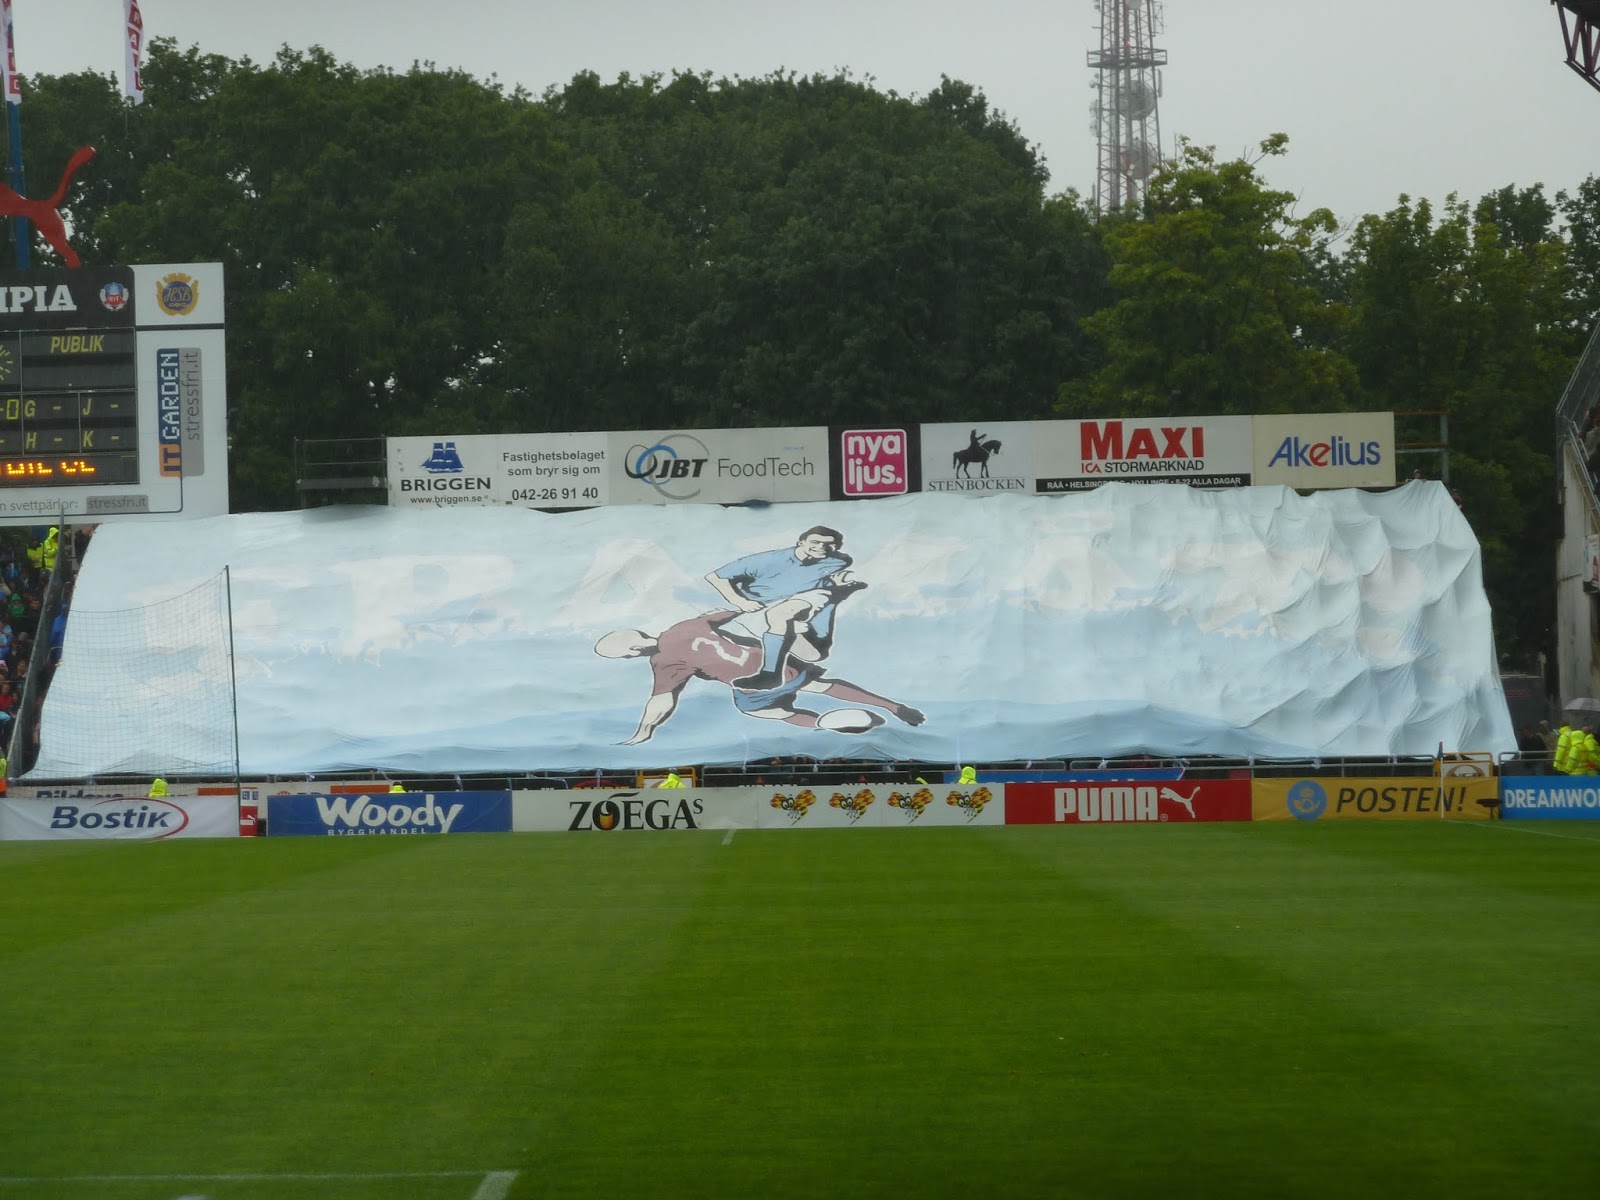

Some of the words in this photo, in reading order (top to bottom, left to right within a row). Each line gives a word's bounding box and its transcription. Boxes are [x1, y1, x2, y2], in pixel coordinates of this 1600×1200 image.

[51, 335, 104, 353] PUBLIK
[161, 353, 180, 440] GARDEN
[182, 351, 200, 440] stressfri.it
[24, 400, 36, 417] G
[83, 398, 92, 416] J
[26, 432, 37, 449] H
[83, 430, 94, 447] K
[1080, 421, 1204, 460] MAXI
[503, 450, 605, 463] Fastighetsbolaget
[848, 434, 901, 462] nya
[1267, 436, 1381, 467] Akelius
[163, 447, 181, 472] IT
[656, 459, 708, 478] JBT
[717, 457, 814, 477] FoodTech
[1081, 462, 1102, 474] ICA
[1104, 460, 1204, 473] STORMARKNAD
[508, 468, 532, 476] som
[535, 466, 559, 477] bryr
[562, 465, 579, 477] sig
[582, 466, 600, 474] om
[848, 458, 903, 492] ljus.
[401, 477, 491, 491] BRIGGEN
[928, 478, 1025, 492] STENBOCKEN
[1192, 478, 1212, 486] ALLA
[1213, 476, 1241, 485] DAGAR
[88, 496, 147, 509] stressfri.it
[410, 495, 482, 504] www.briggen.se
[512, 488, 557, 500] 042-26
[561, 487, 576, 499] 91
[582, 487, 598, 499] 40
[1054, 786, 1158, 821] PUMA
[1336, 786, 1467, 813] POSTEN!
[1505, 788, 1600, 808] DREAMWO
[50, 805, 171, 829] Bostik
[316, 794, 464, 834] Woody
[328, 827, 427, 836] BYGGHANDEL
